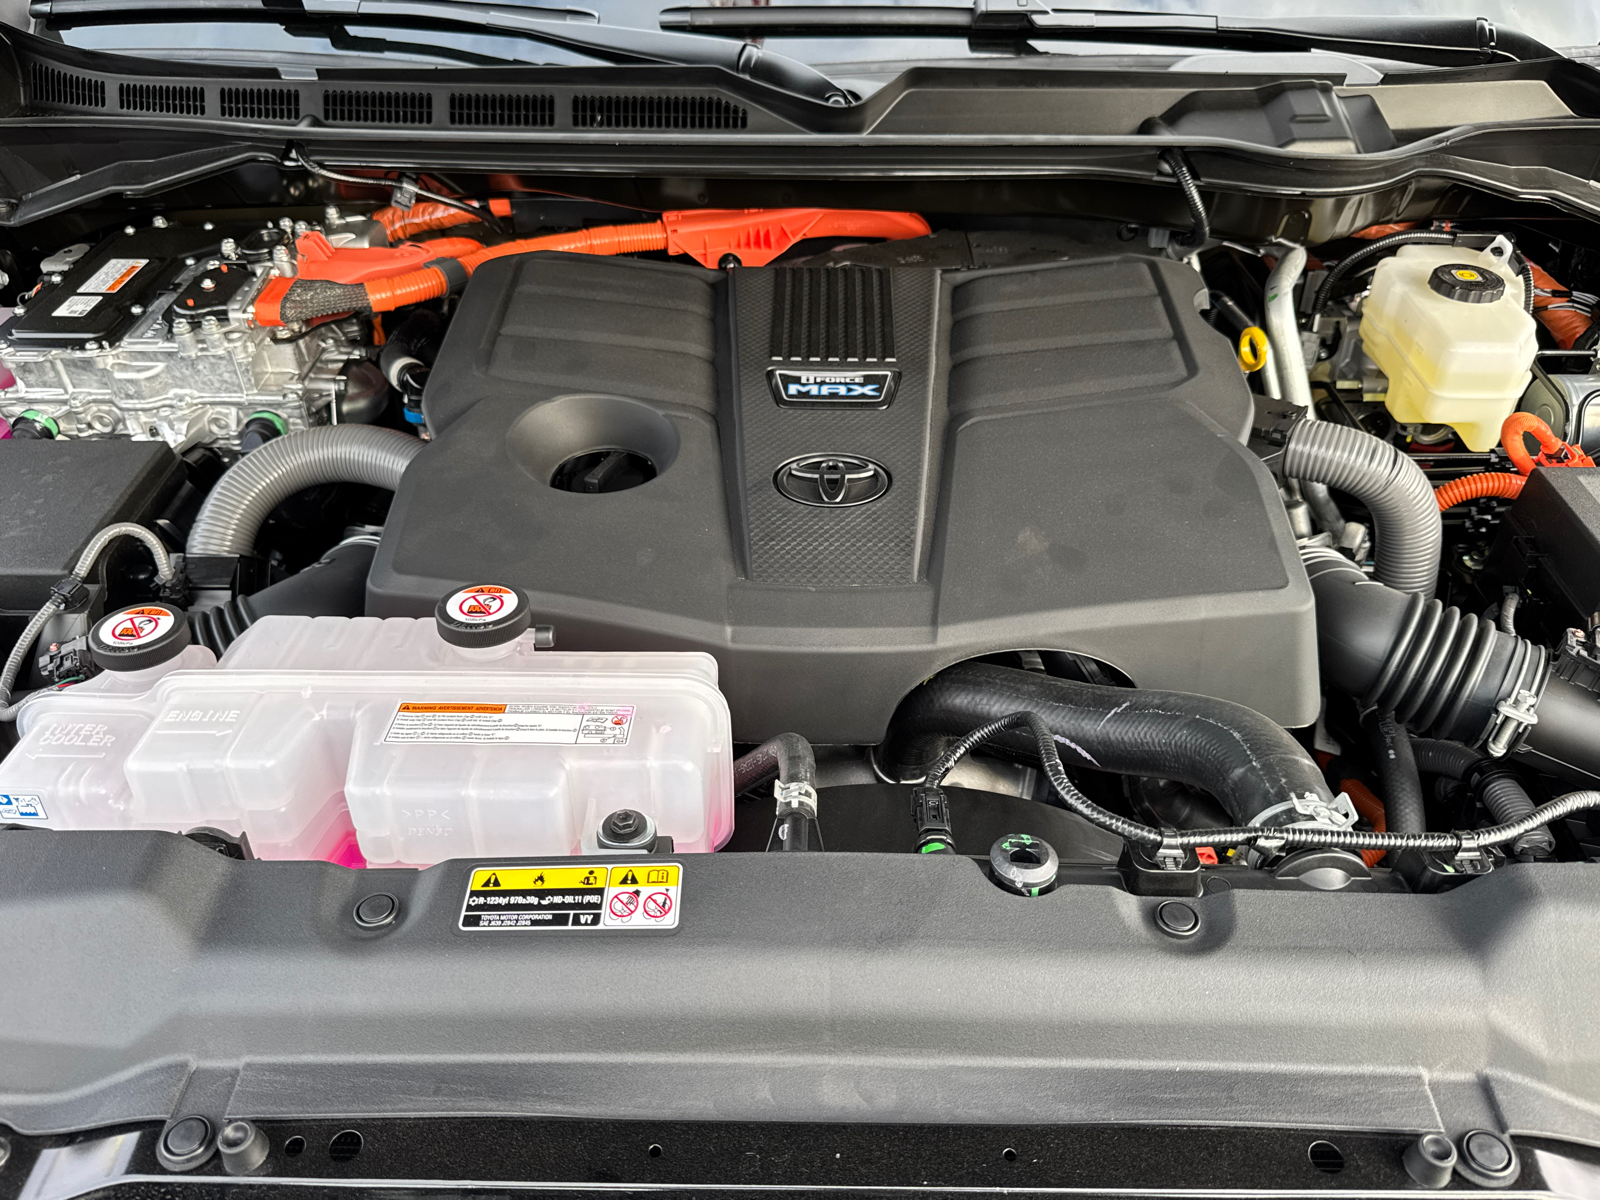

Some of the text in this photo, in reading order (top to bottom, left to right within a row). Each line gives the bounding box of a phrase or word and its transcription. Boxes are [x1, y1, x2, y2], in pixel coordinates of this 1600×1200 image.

[787, 383, 880, 396] MAX
[163, 710, 241, 723] ENGINE
[45, 723, 109, 736] INTER
[38, 734, 116, 748] COOLER
[478, 896, 510, 905] R-1234yf
[510, 895, 539, 905] 970±30g
[582, 894, 602, 904] (POE)
[579, 914, 594, 924] VY
